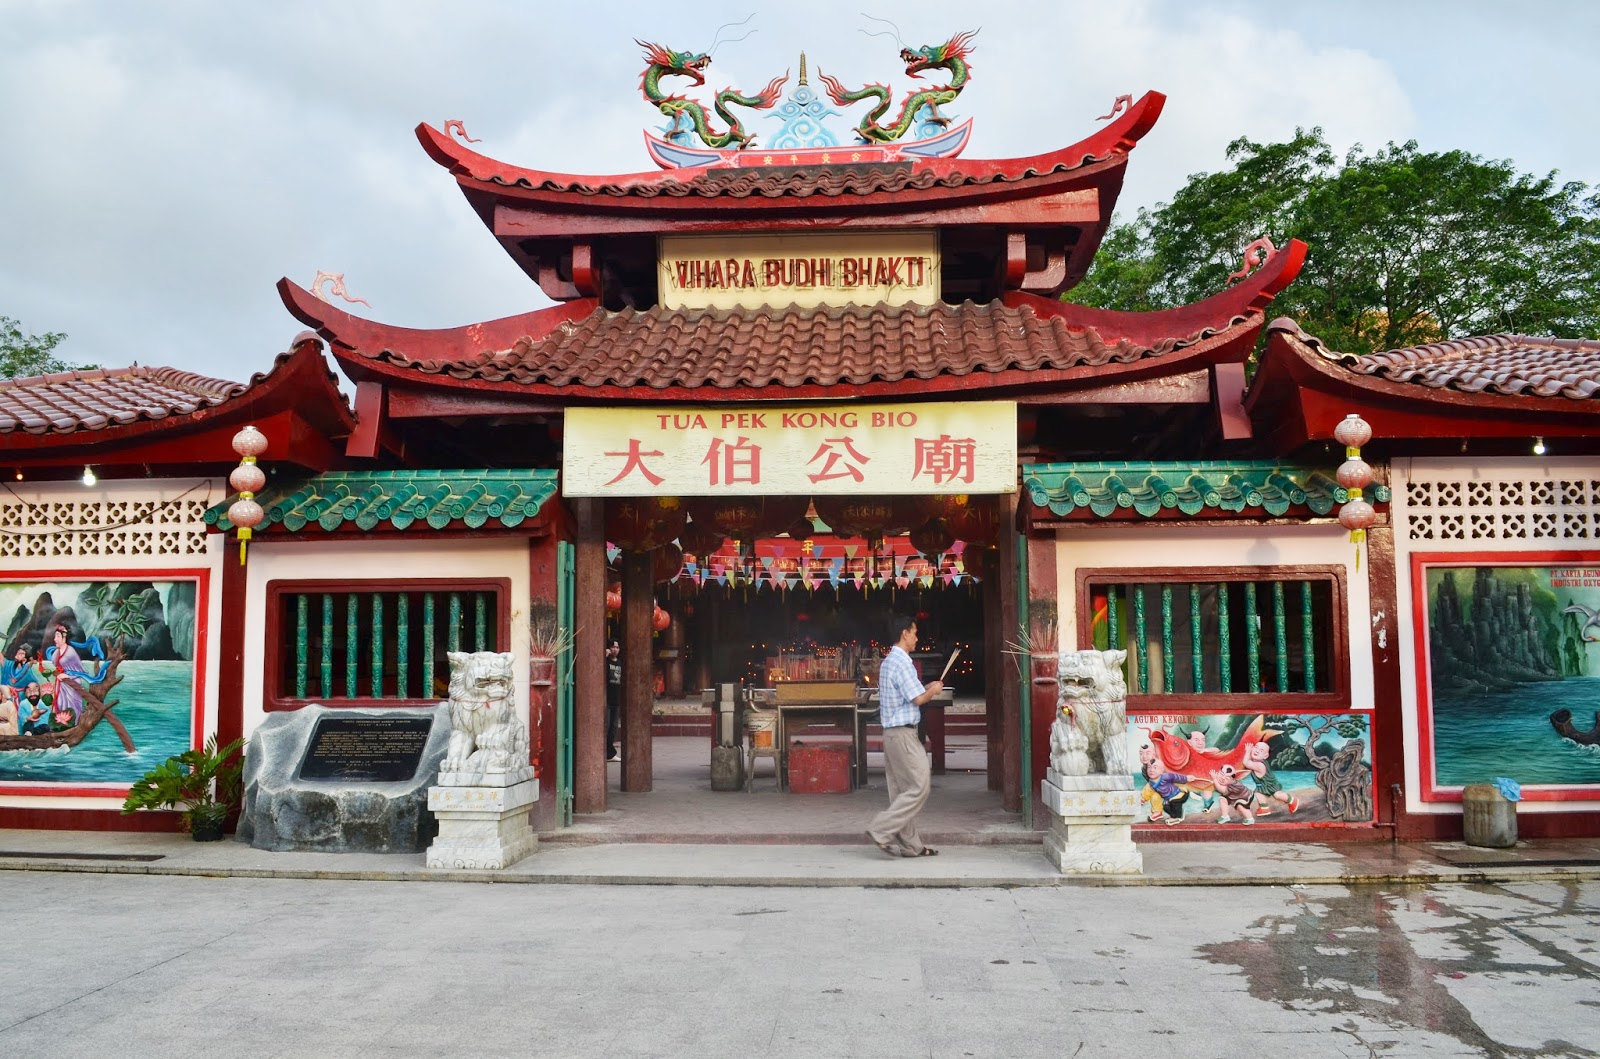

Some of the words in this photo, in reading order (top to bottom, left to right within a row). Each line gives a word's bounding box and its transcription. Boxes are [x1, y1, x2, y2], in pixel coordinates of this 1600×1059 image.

[675, 259, 756, 289] VIHARA
[765, 258, 831, 288] BUDHI
[843, 256, 924, 287] BHAKTI
[657, 414, 708, 430] TUA
[721, 413, 767, 429] PEK
[782, 412, 859, 429] KONG
[871, 411, 918, 428] BIO
[603, 434, 977, 487] 大伯公廟
[1560, 569, 1582, 578] KARTA
[1550, 579, 1582, 587] INDUSTRI
[1134, 715, 1159, 724] AGUNG
